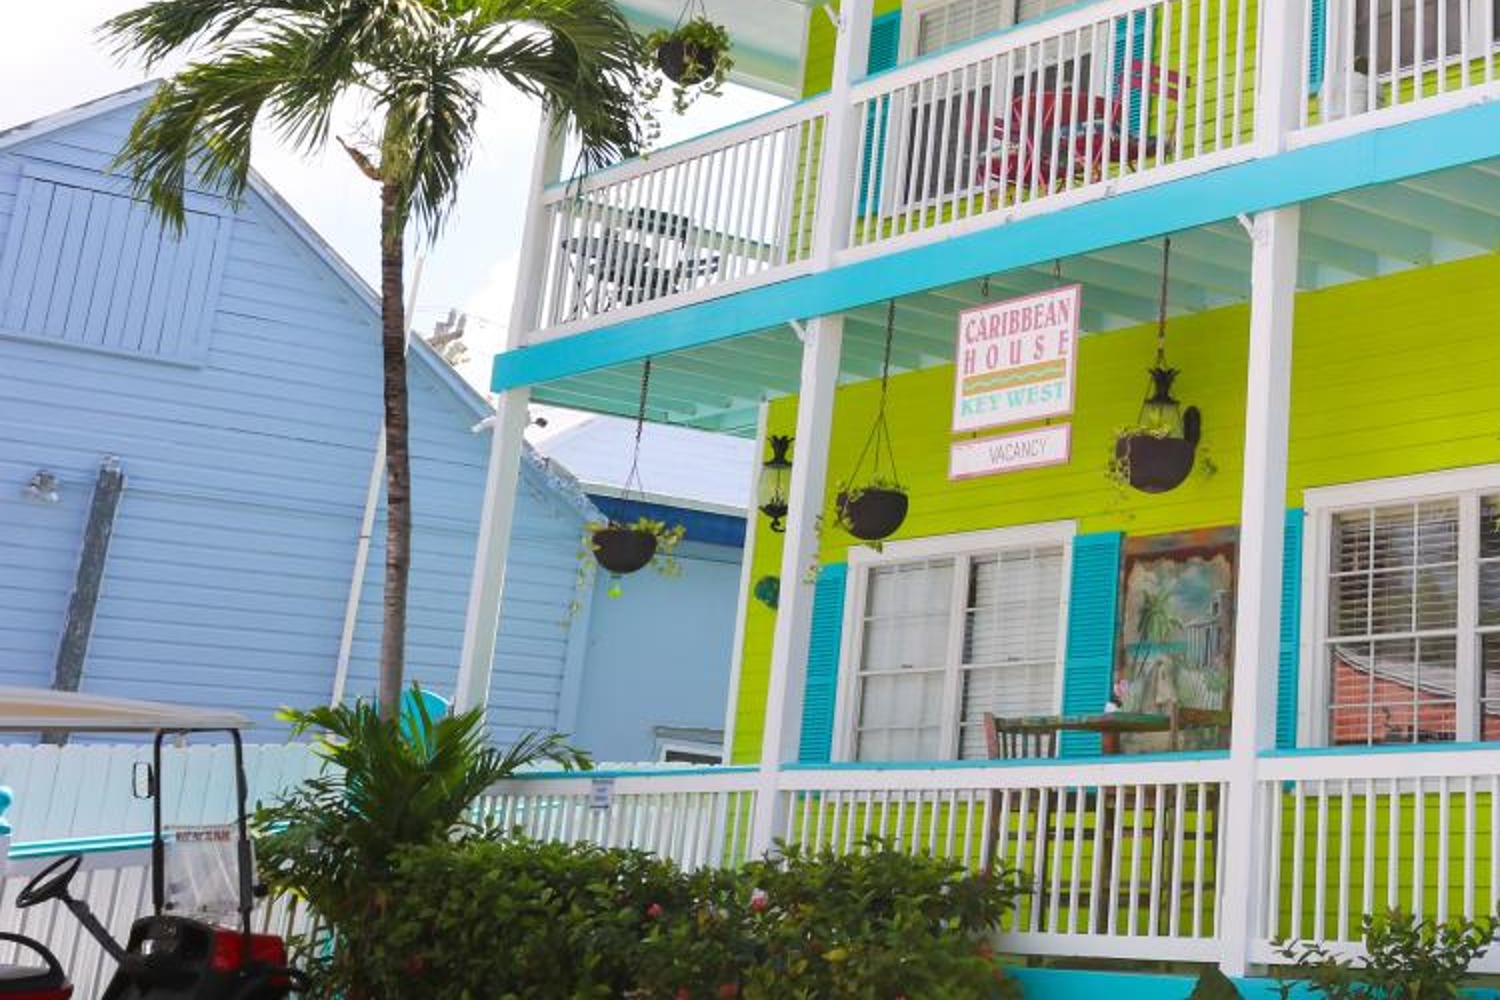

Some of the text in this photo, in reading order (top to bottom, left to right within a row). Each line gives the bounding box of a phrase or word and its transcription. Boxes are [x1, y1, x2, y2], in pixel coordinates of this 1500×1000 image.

[964, 297, 1071, 345] CARIBBEAN
[964, 330, 1069, 375] HOUSE
[961, 383, 1065, 417] KEY WEST
[987, 438, 1048, 465] VACANCY
